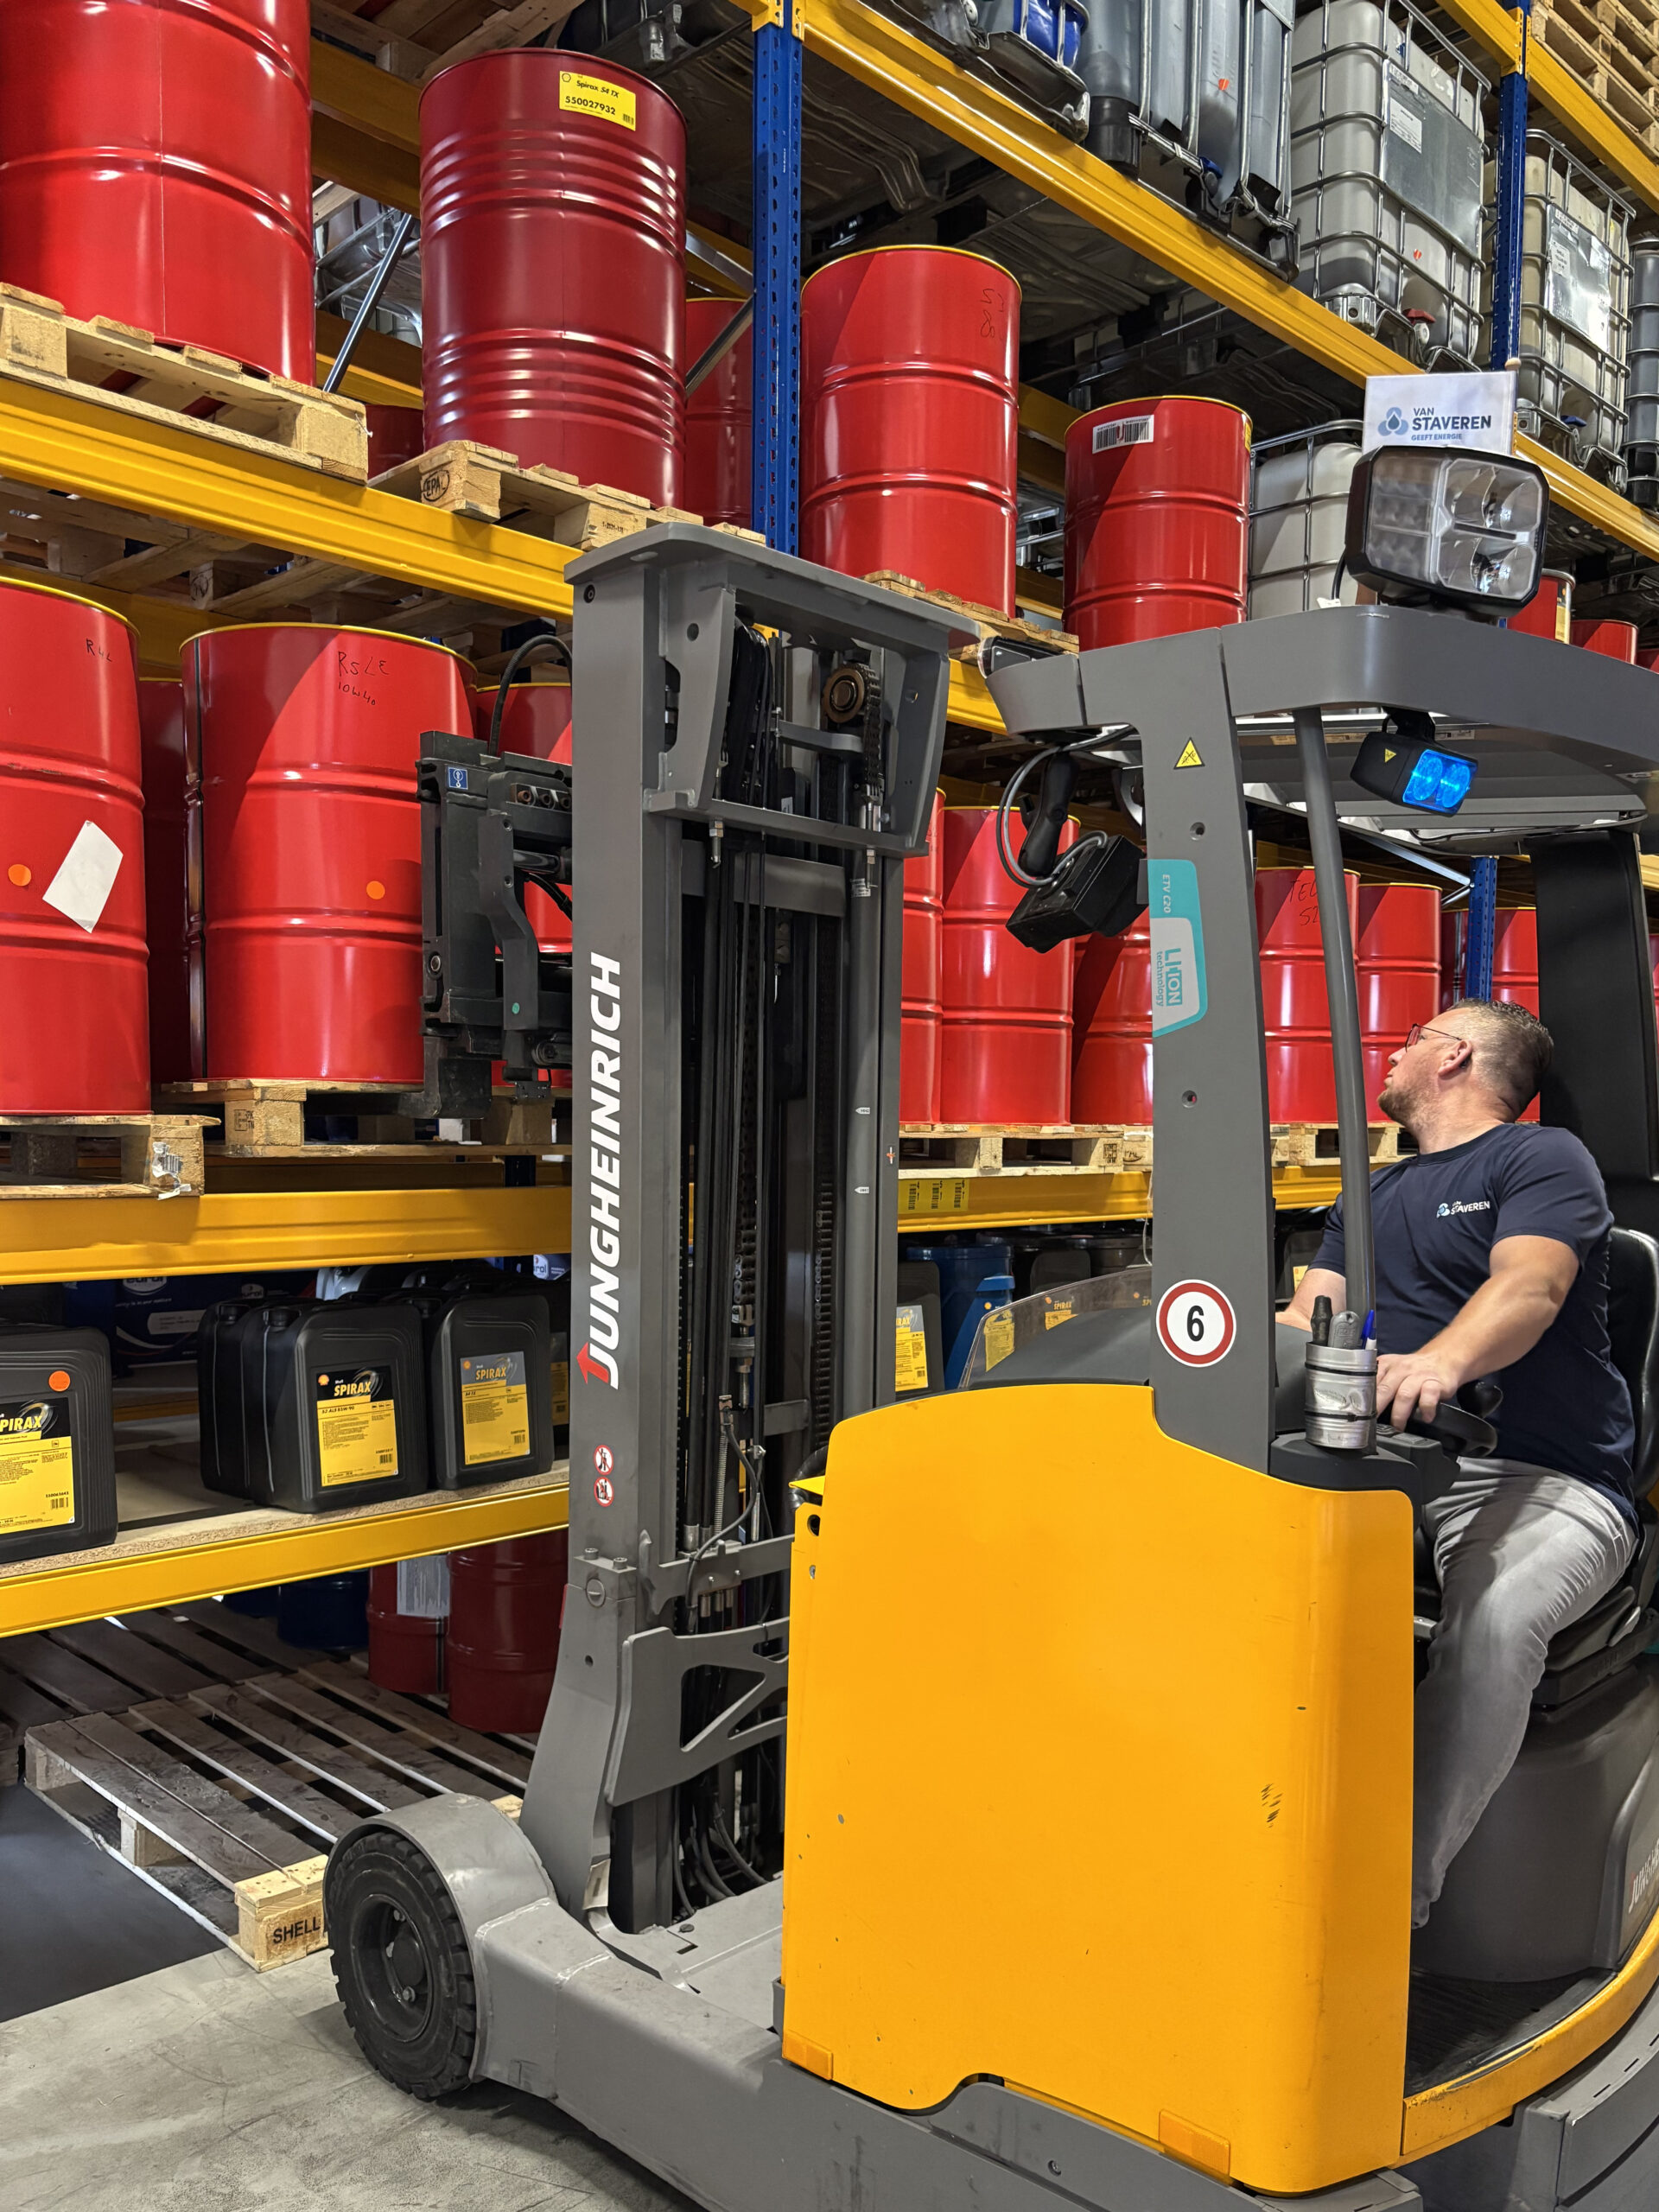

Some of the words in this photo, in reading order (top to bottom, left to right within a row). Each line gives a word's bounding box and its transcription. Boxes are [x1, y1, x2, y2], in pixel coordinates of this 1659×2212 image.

[576, 79, 599, 92] Spirax
[611, 90, 620, 99] TX
[565, 95, 616, 115] 550027932
[1413, 407, 1434, 416] VAN
[1412, 415, 1492, 431] STAVEREN
[1163, 895, 1172, 913] C20
[1155, 951, 1164, 1007] technology
[589, 951, 621, 1390] JUNGHEINRICH
[1186, 1305, 1205, 1343] 6
[476, 1367, 507, 1381] SPIRAX
[334, 1381, 372, 1397] SPIRAX
[0, 1415, 42, 1433] PIRAX
[273, 1916, 321, 1944] SHELL
